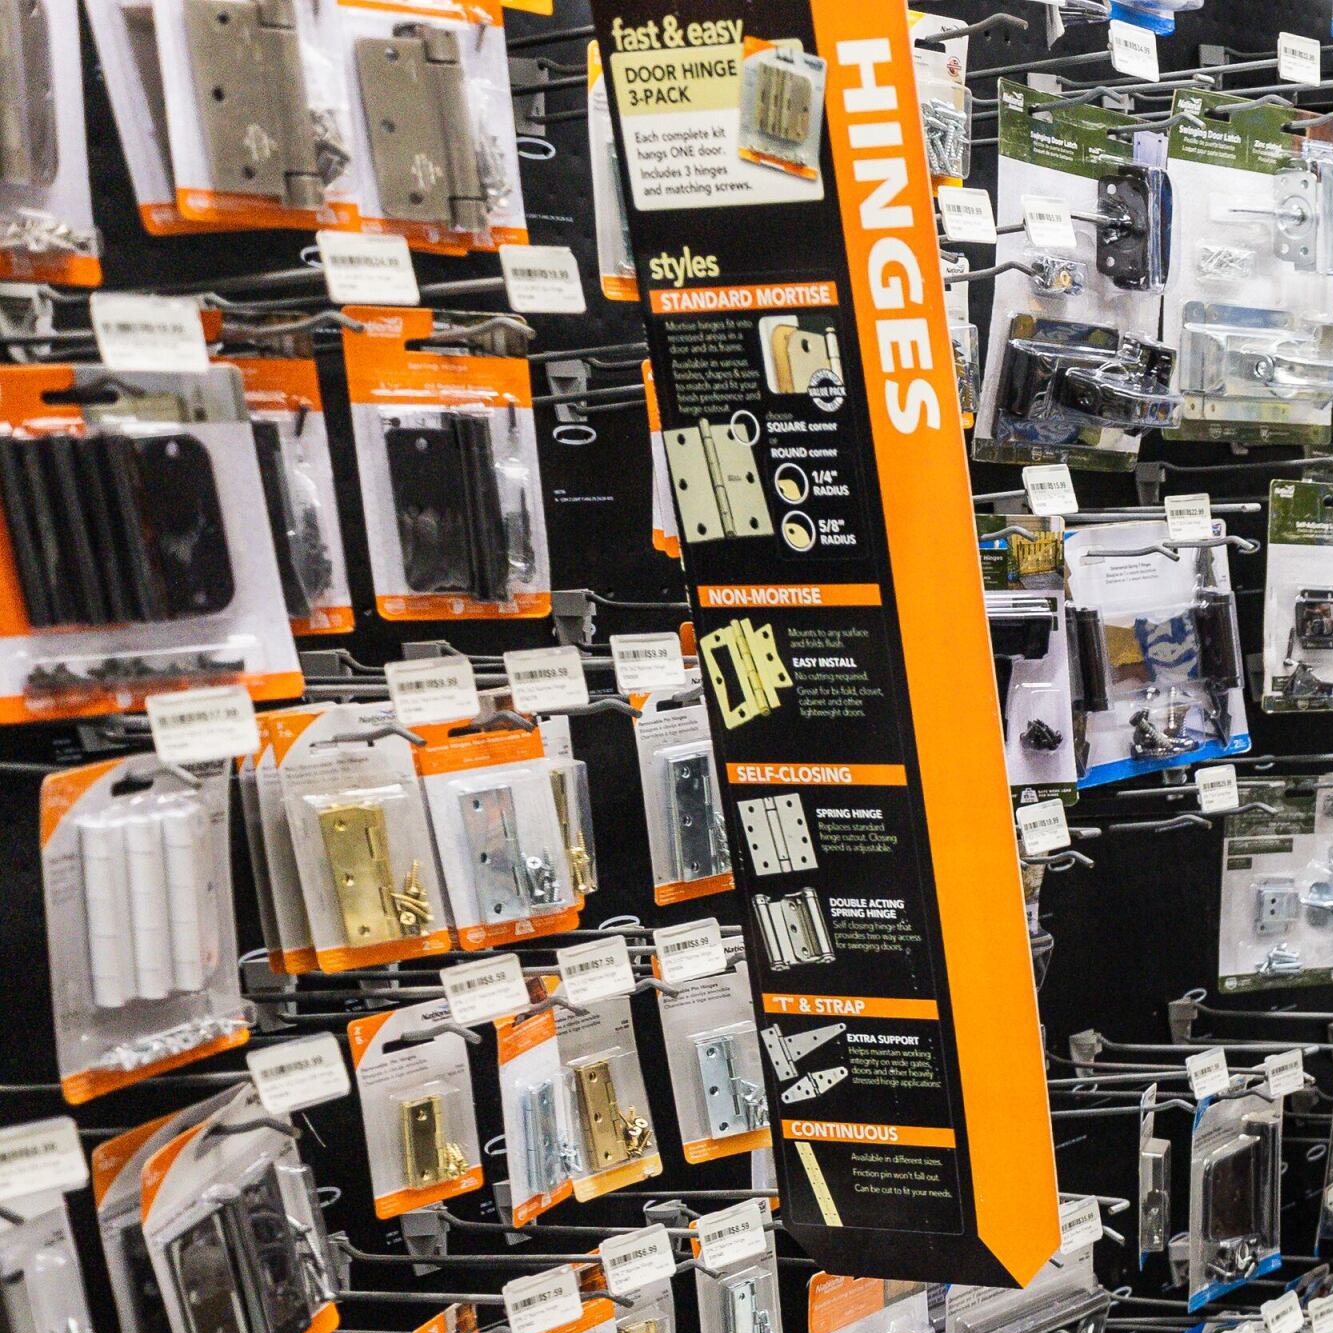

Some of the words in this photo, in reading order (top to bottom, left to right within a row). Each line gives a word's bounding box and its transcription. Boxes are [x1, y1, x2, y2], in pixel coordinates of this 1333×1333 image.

[612, 16, 660, 51] fast
[663, 15, 684, 48] &
[688, 19, 743, 47] easy
[625, 63, 676, 83] DOOR
[683, 60, 737, 80] HINGE
[629, 86, 691, 106] 3-PACK
[635, 131, 659, 143] Each
[663, 129, 708, 143] complete
[712, 128, 725, 138] kit
[638, 149, 666, 162] hangs
[670, 146, 695, 157] ONE
[641, 166, 682, 179] Includes
[685, 166, 692, 177] 3
[694, 165, 728, 179] hinges
[644, 185, 662, 196] and
[665, 182, 711, 196] matching
[837, 38, 940, 434] HINGES
[650, 246, 720, 287] styles
[661, 289, 752, 311] STANDARD
[756, 286, 831, 306] MORTISE
[767, 422, 807, 433] SQUARE
[808, 423, 838, 432] corner
[771, 448, 807, 458] ROUND
[809, 448, 838, 458] corner
[813, 485, 849, 496] RADIUS
[820, 534, 856, 545] RADIUS
[709, 588, 822, 605] NON-MORTISE
[793, 658, 817, 668] EASY
[818, 658, 857, 667] INSTALL
[737, 766, 852, 783] SELF-CLOSING
[816, 809, 850, 819] SPRING
[853, 809, 883, 819] HINGE
[829, 898, 867, 908] DOUBLE
[869, 899, 904, 909] ACTING
[832, 908, 865, 918] SPRING
[867, 909, 896, 919] HINGE
[800, 998, 812, 1012] &
[815, 999, 865, 1015] STRAP
[847, 1033, 877, 1043] EXTRA
[878, 1035, 919, 1045] SUPPORT
[791, 1122, 898, 1141] CONTINUOUS
[731, 1222, 750, 1234] $8.59
[637, 1245, 657, 1258] $6.99
[541, 1288, 563, 1302] $7.59
